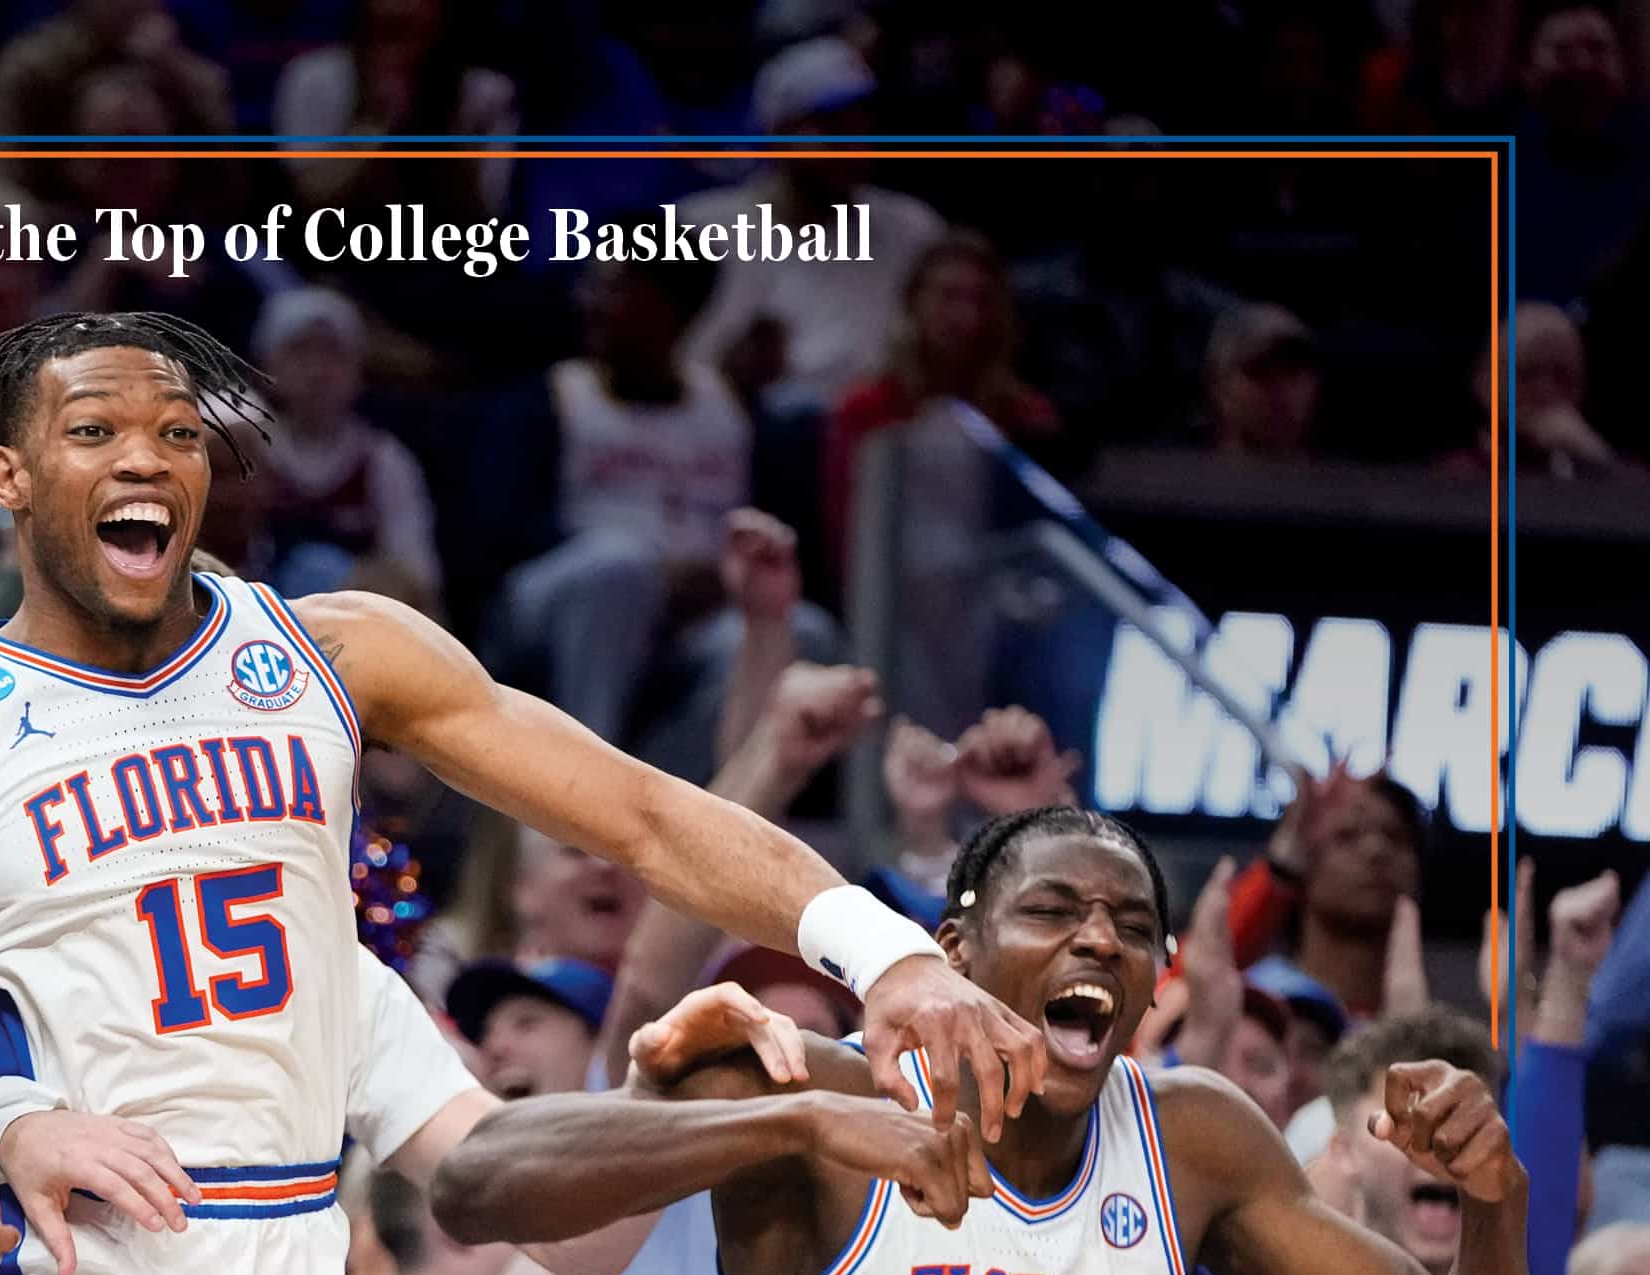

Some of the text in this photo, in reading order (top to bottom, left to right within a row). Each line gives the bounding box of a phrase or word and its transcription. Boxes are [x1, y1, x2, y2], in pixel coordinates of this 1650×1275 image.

[235, 643, 288, 694] SEC
[239, 685, 301, 709] GRADUATE
[1094, 608, 1650, 842] MARC
[23, 735, 326, 886] FLORIDA
[135, 862, 294, 1035] 15
[1102, 1196, 1144, 1247] SEC
